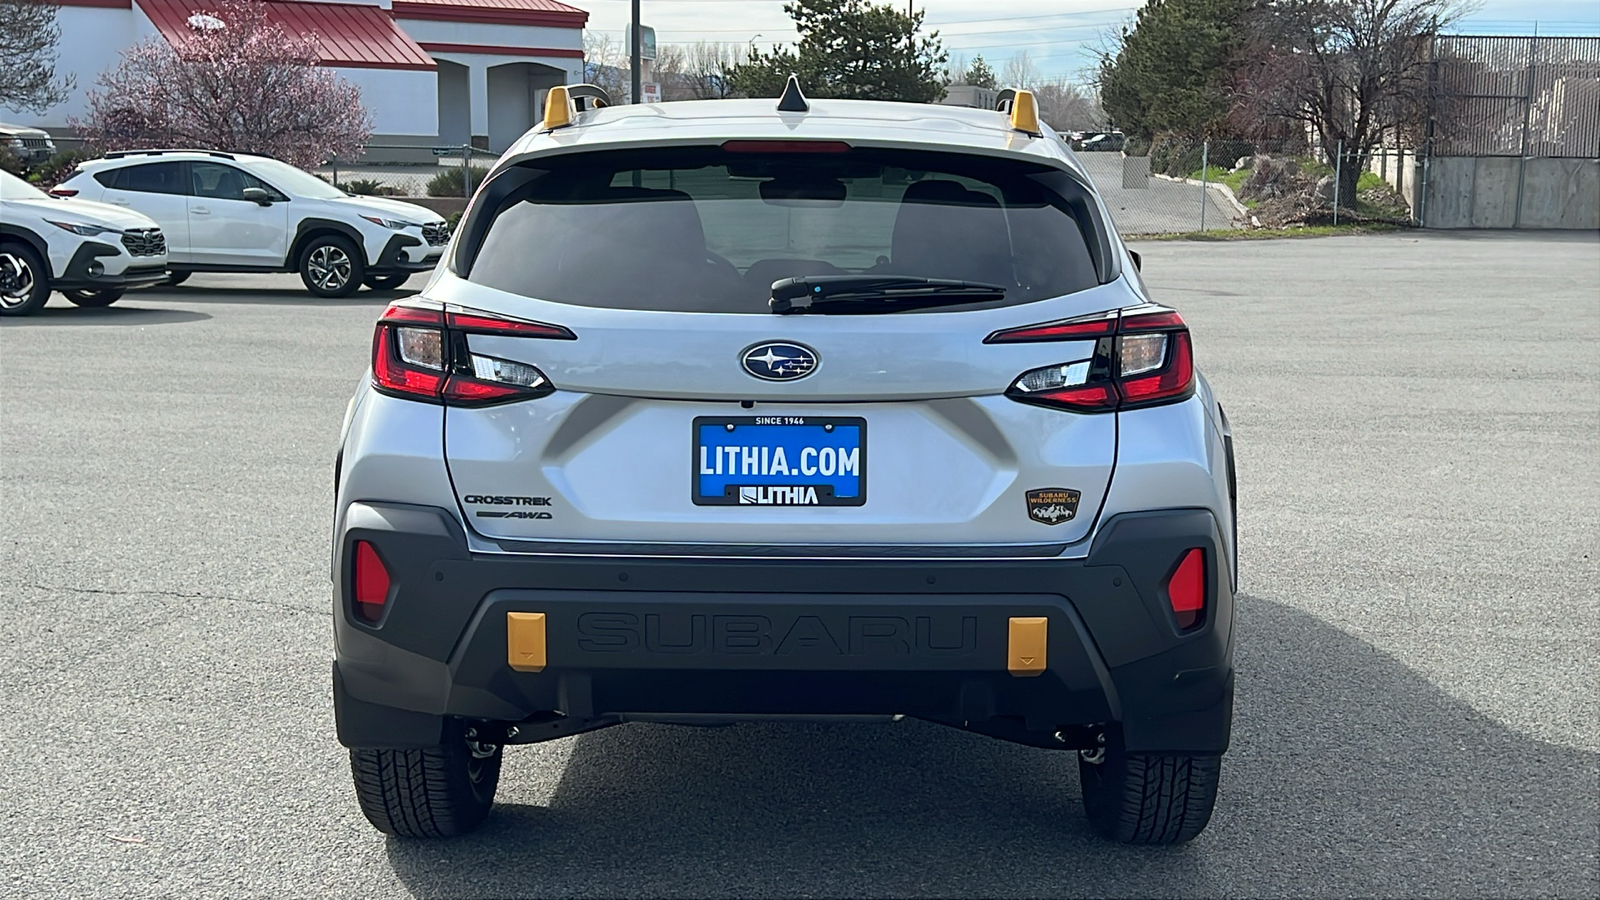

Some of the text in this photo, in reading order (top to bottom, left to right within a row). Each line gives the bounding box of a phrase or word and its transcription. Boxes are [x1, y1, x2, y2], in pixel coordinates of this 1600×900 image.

[755, 417, 804, 425] SINCE 1946
[700, 446, 859, 476] LITHIA.COM
[464, 495, 552, 506] CROSSTREK
[757, 486, 819, 504] LITHIA
[504, 511, 553, 519] AWD
[577, 612, 978, 656] SUBARU
